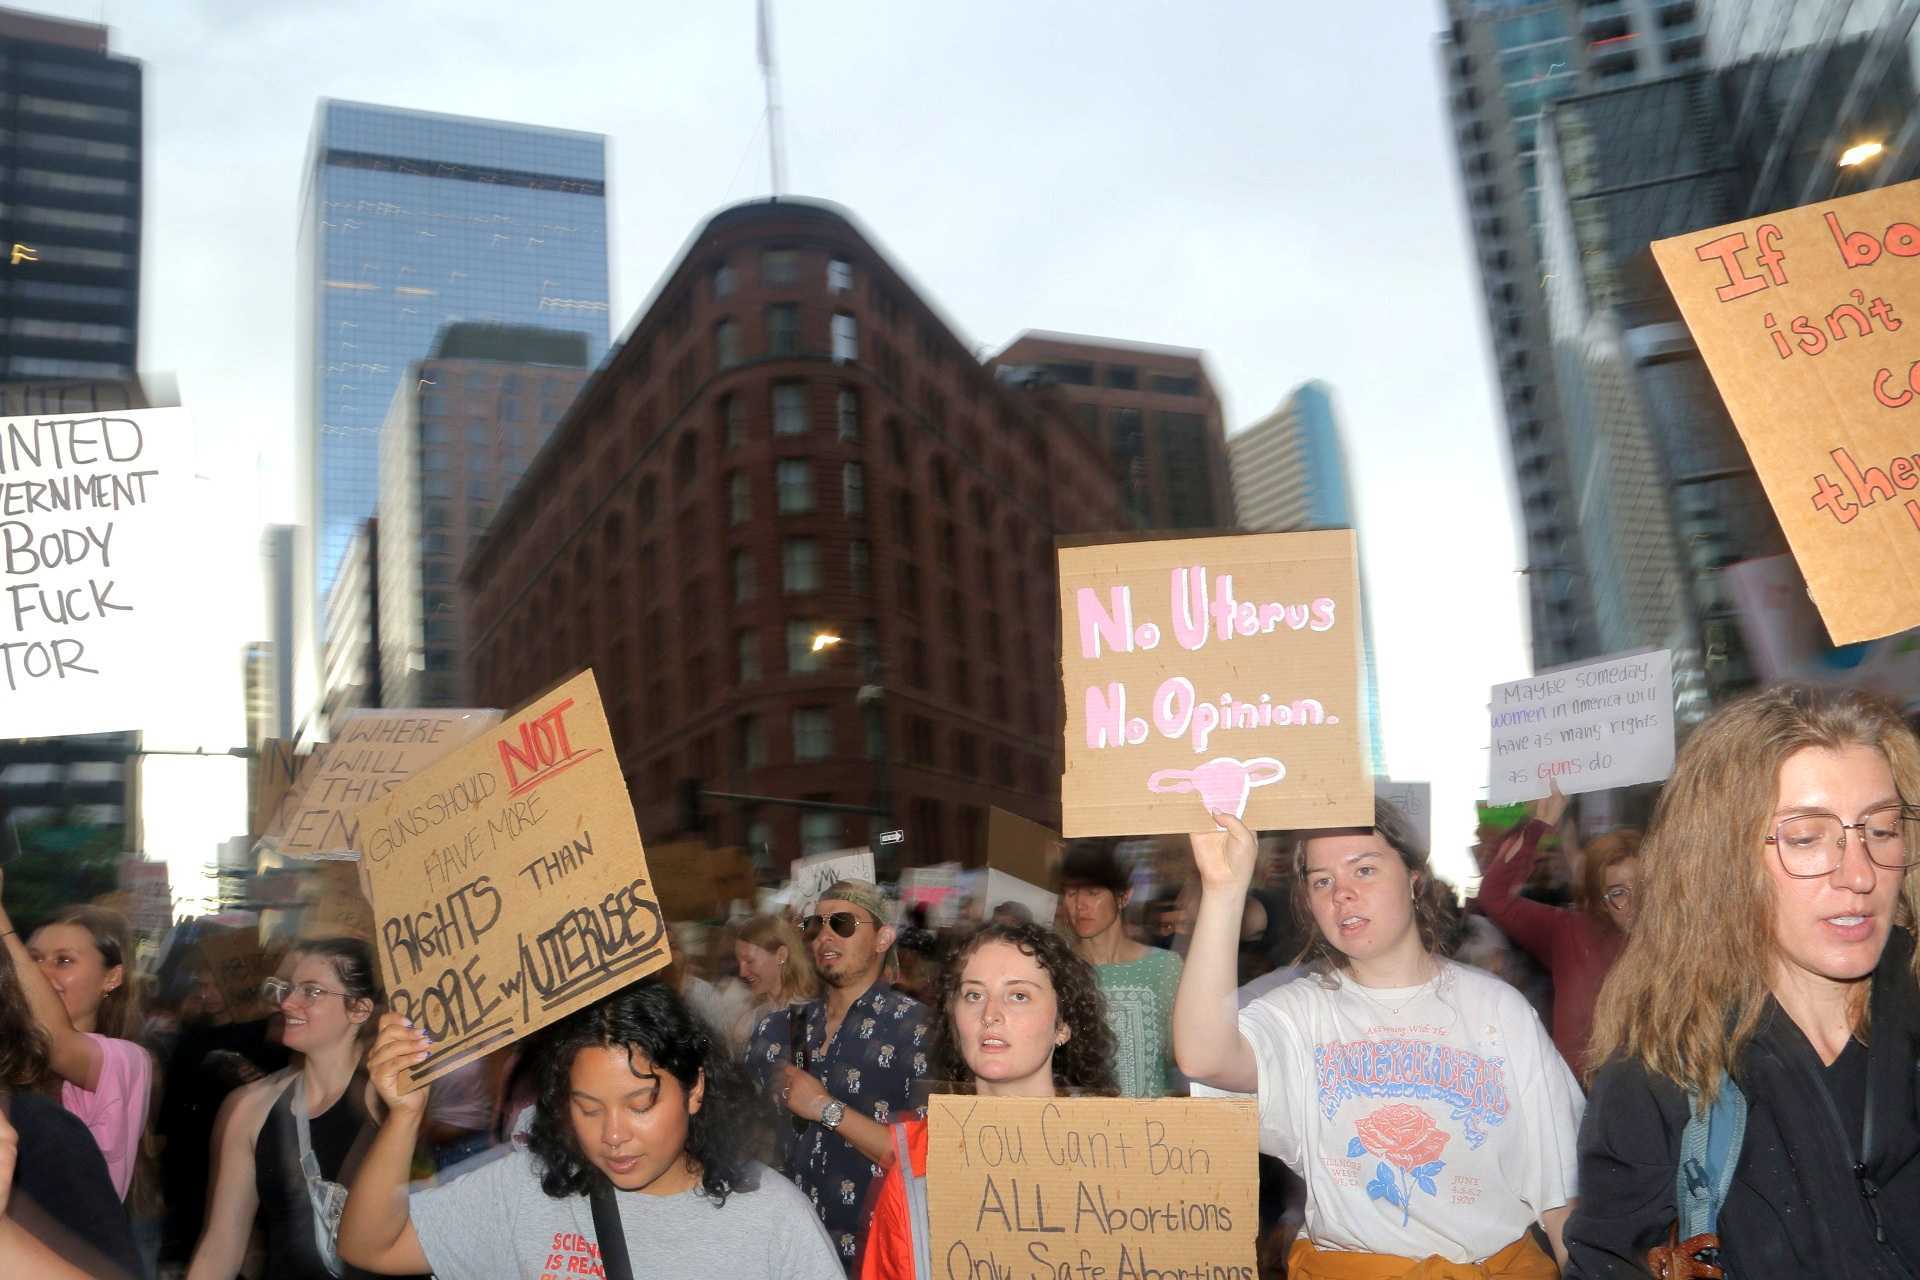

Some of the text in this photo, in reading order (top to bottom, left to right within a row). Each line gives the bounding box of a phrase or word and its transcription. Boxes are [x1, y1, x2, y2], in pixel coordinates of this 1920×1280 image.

[1695, 224, 1790, 303] If
[1764, 289, 1902, 359] isn't
[1873, 360, 1920, 408] c
[0, 418, 143, 474] NTED
[0, 470, 158, 516] ERNMENT
[1811, 447, 1920, 524] the
[0, 520, 114, 575] BODY
[5, 579, 134, 631] FUCK
[1077, 565, 1335, 659] No Uterus
[0, 638, 99, 691] TOR
[1504, 678, 1566, 704] Maybe
[347, 718, 453, 744] WHERE
[1085, 676, 1340, 753] No Opinion.
[1491, 706, 1547, 728] women
[1552, 703, 1567, 719] in
[1626, 687, 1656, 705] will
[1497, 713, 1658, 756] have as many rights
[329, 750, 409, 774] WILL
[369, 698, 575, 862] GUNS SHOULD NOT
[1507, 768, 1528, 784] as
[1589, 752, 1613, 772] do
[424, 791, 549, 892] HAVE MORE
[383, 830, 594, 985] RIGHTS THAN
[940, 1101, 1210, 1175] You Can't Ban
[976, 1174, 1233, 1235] ALL Abortions
[544, 1254, 564, 1270] IS
[1027, 1241, 1106, 1280] Safe
[1119, 1243, 1253, 1280] Abortions
